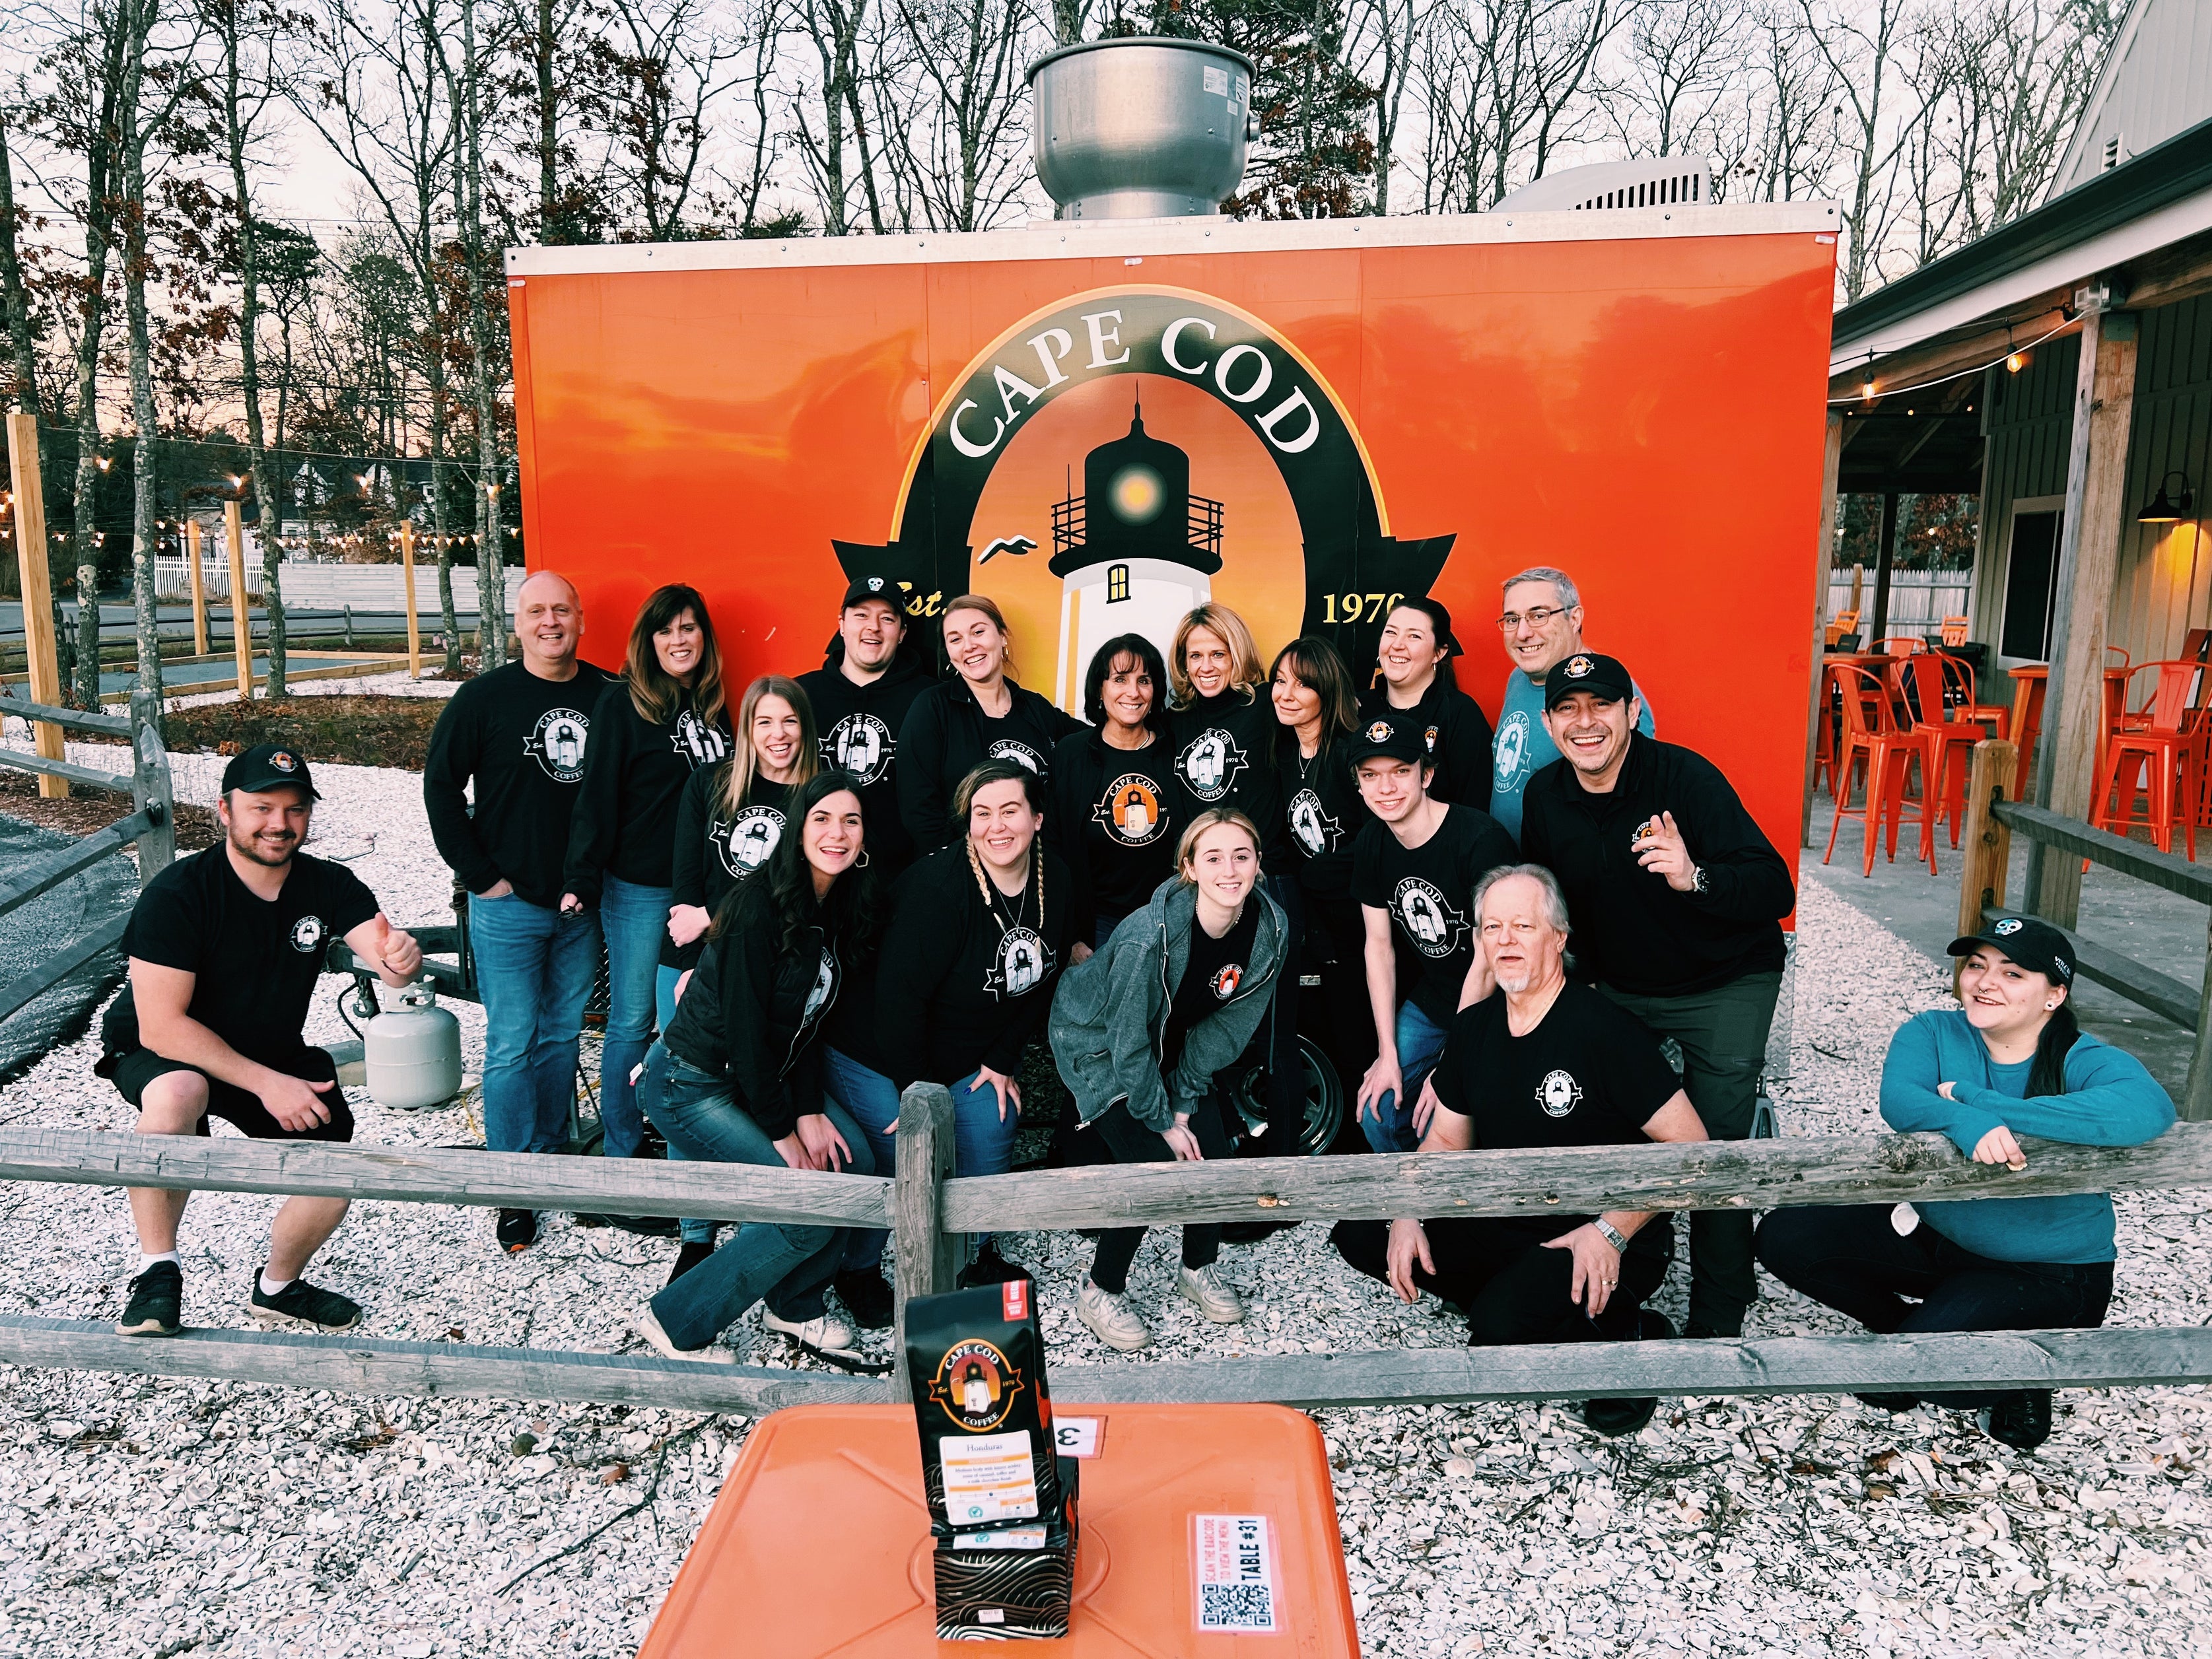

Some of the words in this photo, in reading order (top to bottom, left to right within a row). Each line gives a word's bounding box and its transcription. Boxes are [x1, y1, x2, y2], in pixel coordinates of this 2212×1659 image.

[950, 309, 1130, 457] CAPE
[1161, 317, 1320, 453] COD
[539, 710, 563, 729] CAPE
[565, 711, 590, 728] COD
[837, 716, 862, 732] CAE
[865, 718, 884, 733] COD
[1503, 714, 1521, 729] CAPE
[1214, 730, 1231, 745] COD
[989, 742, 1008, 758] CAPE
[1010, 743, 1034, 756] COD
[859, 773, 874, 783] FEE
[1109, 776, 1133, 796] CAPE
[1135, 777, 1157, 794] COD
[1197, 786, 1224, 797] COFFEE
[1306, 793, 1319, 811] COD
[736, 808, 765, 821] CAPE
[1398, 879, 1418, 897] CAPE
[1419, 882, 1441, 902] COD
[1000, 931, 1018, 956] CAPE
[1420, 943, 1450, 955] COFFEE
[1544, 1071, 1558, 1083] CAPE
[1560, 1072, 1572, 1083] COD
[945, 1344, 971, 1370] CAPE
[974, 1344, 1000, 1365] COD
[963, 1411, 1000, 1427] COFFEE
[967, 1443, 1003, 1452] Honduras
[1218, 1521, 1229, 1538] MENU
[1238, 1520, 1257, 1540] #31
[1219, 1541, 1229, 1551] THE
[1204, 1550, 1215, 1561] THE
[1239, 1544, 1261, 1580] TABLE
[1205, 1563, 1216, 1582] SCAN
